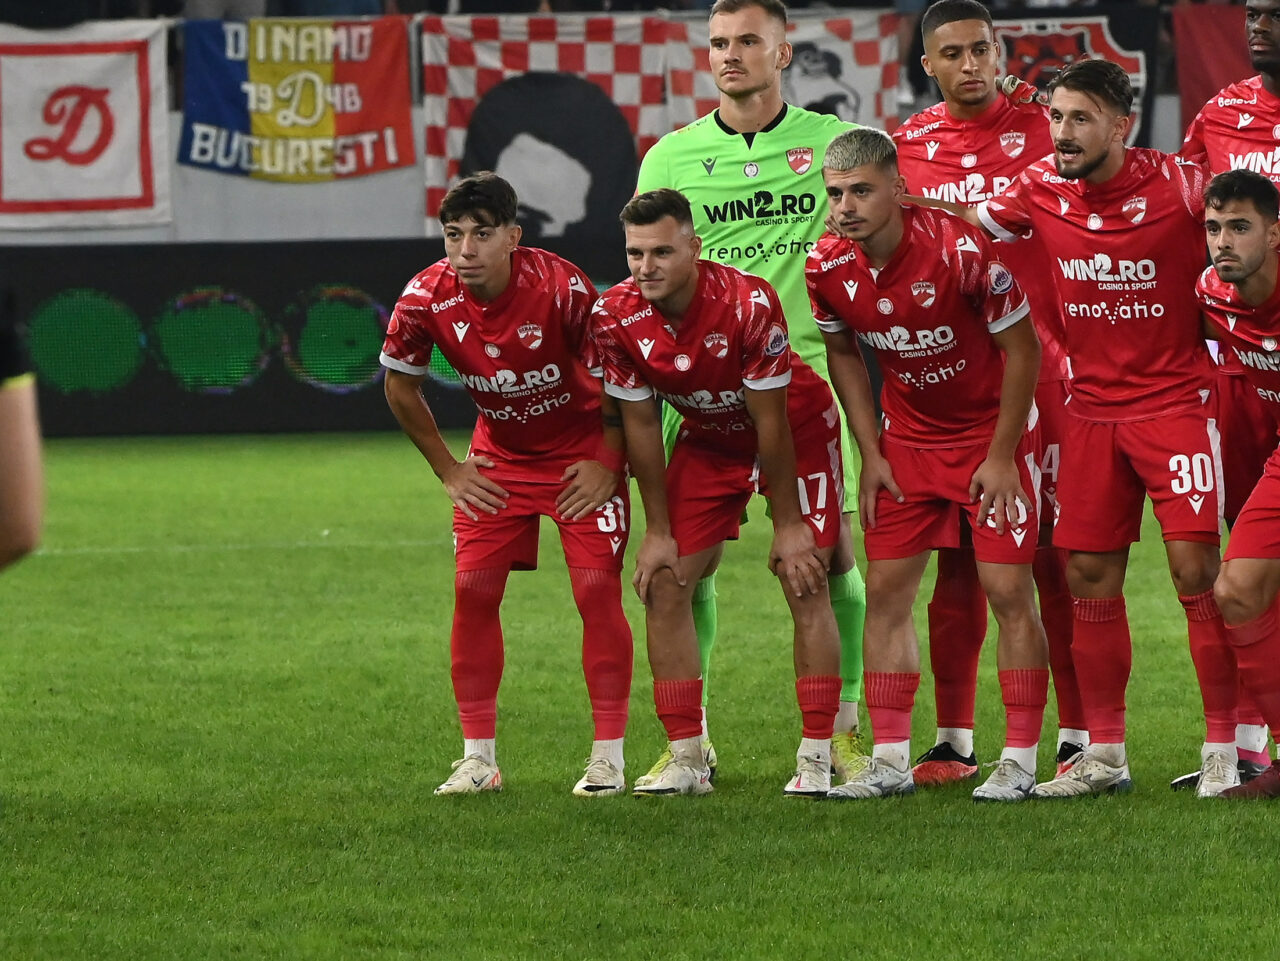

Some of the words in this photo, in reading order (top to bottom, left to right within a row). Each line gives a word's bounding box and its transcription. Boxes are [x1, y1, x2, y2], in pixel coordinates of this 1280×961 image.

[222, 22, 373, 62] DINAMO
[242, 82, 273, 112] 19
[326, 84, 361, 112] 48
[190, 122, 400, 175] BUCURESTI
[703, 190, 816, 224] WIN2.RO
[756, 218, 782, 226] CASINO
[791, 216, 815, 225] SPORT
[1057, 253, 1156, 281] WIN2.RO
[1098, 282, 1123, 290] CASINO
[1131, 281, 1157, 290] SPORT
[857, 325, 954, 351] WIN2.RO
[900, 350, 926, 358] CASINO
[933, 341, 958, 355] SPORT
[459, 363, 561, 393] WIN2.RO
[502, 390, 531, 399] CASINO
[538, 380, 563, 392] SPORT
[1168, 453, 1214, 494] 30
[596, 494, 626, 532] 31
